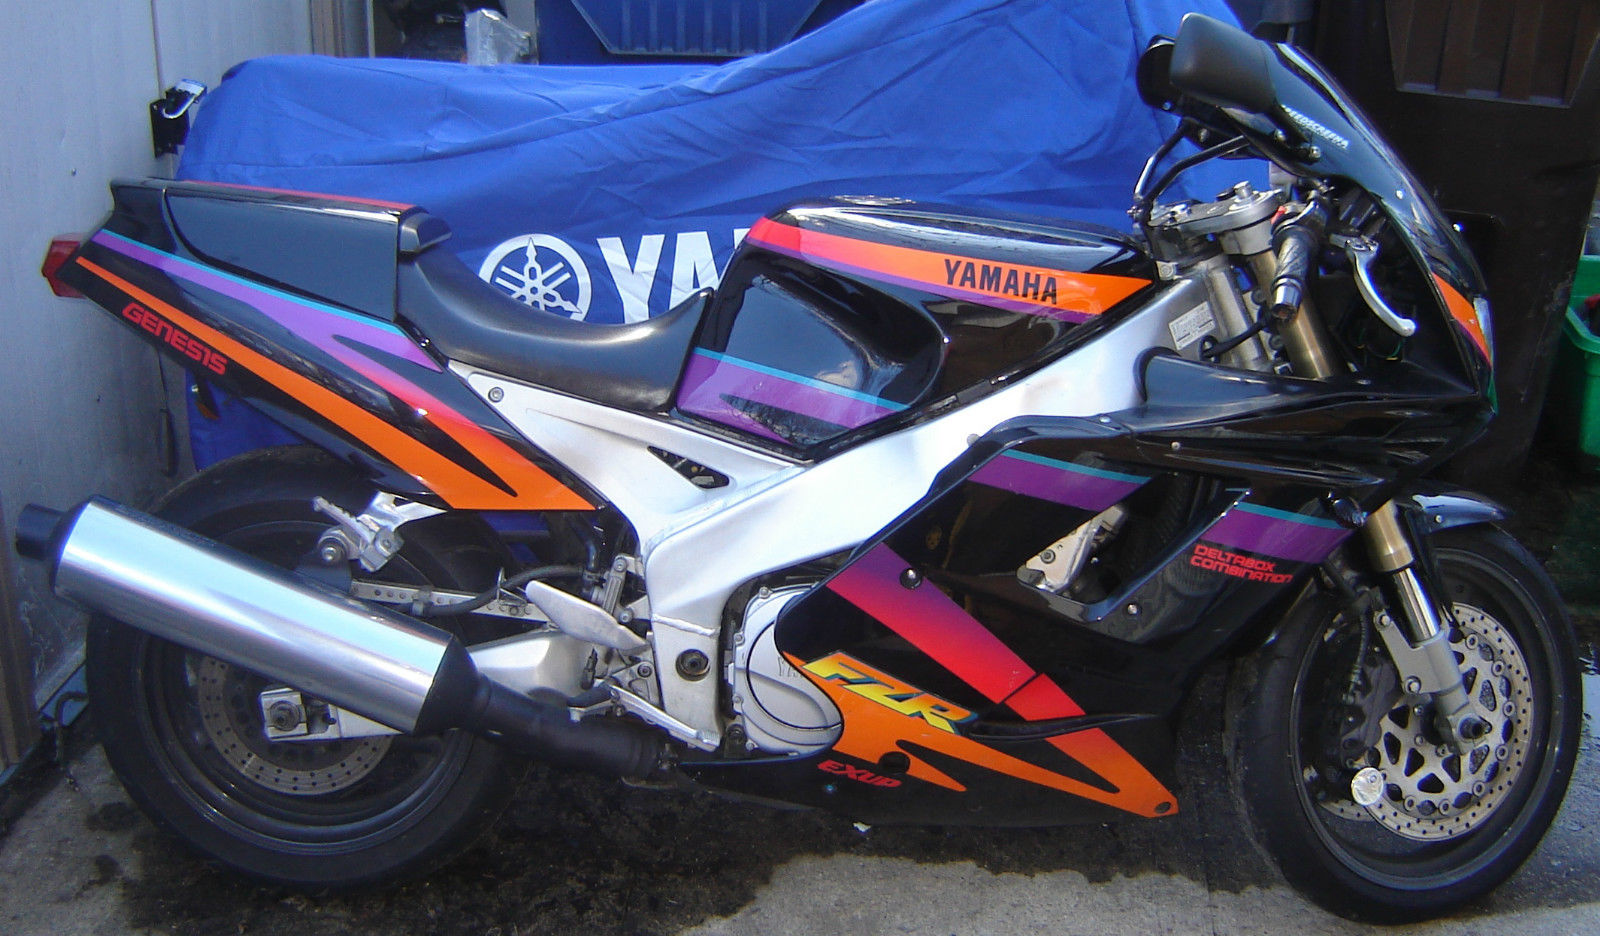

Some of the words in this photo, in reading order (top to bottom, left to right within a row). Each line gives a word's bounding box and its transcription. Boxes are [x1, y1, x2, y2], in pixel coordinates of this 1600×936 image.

[596, 228, 750, 324] YA
[944, 258, 1057, 305] YAMAHA
[122, 302, 228, 375] GENESIS
[1190, 555, 1293, 583] COMBINATION
[1194, 544, 1276, 572] DELTABOX
[802, 651, 979, 736] FZR
[817, 760, 902, 788] EXUP
